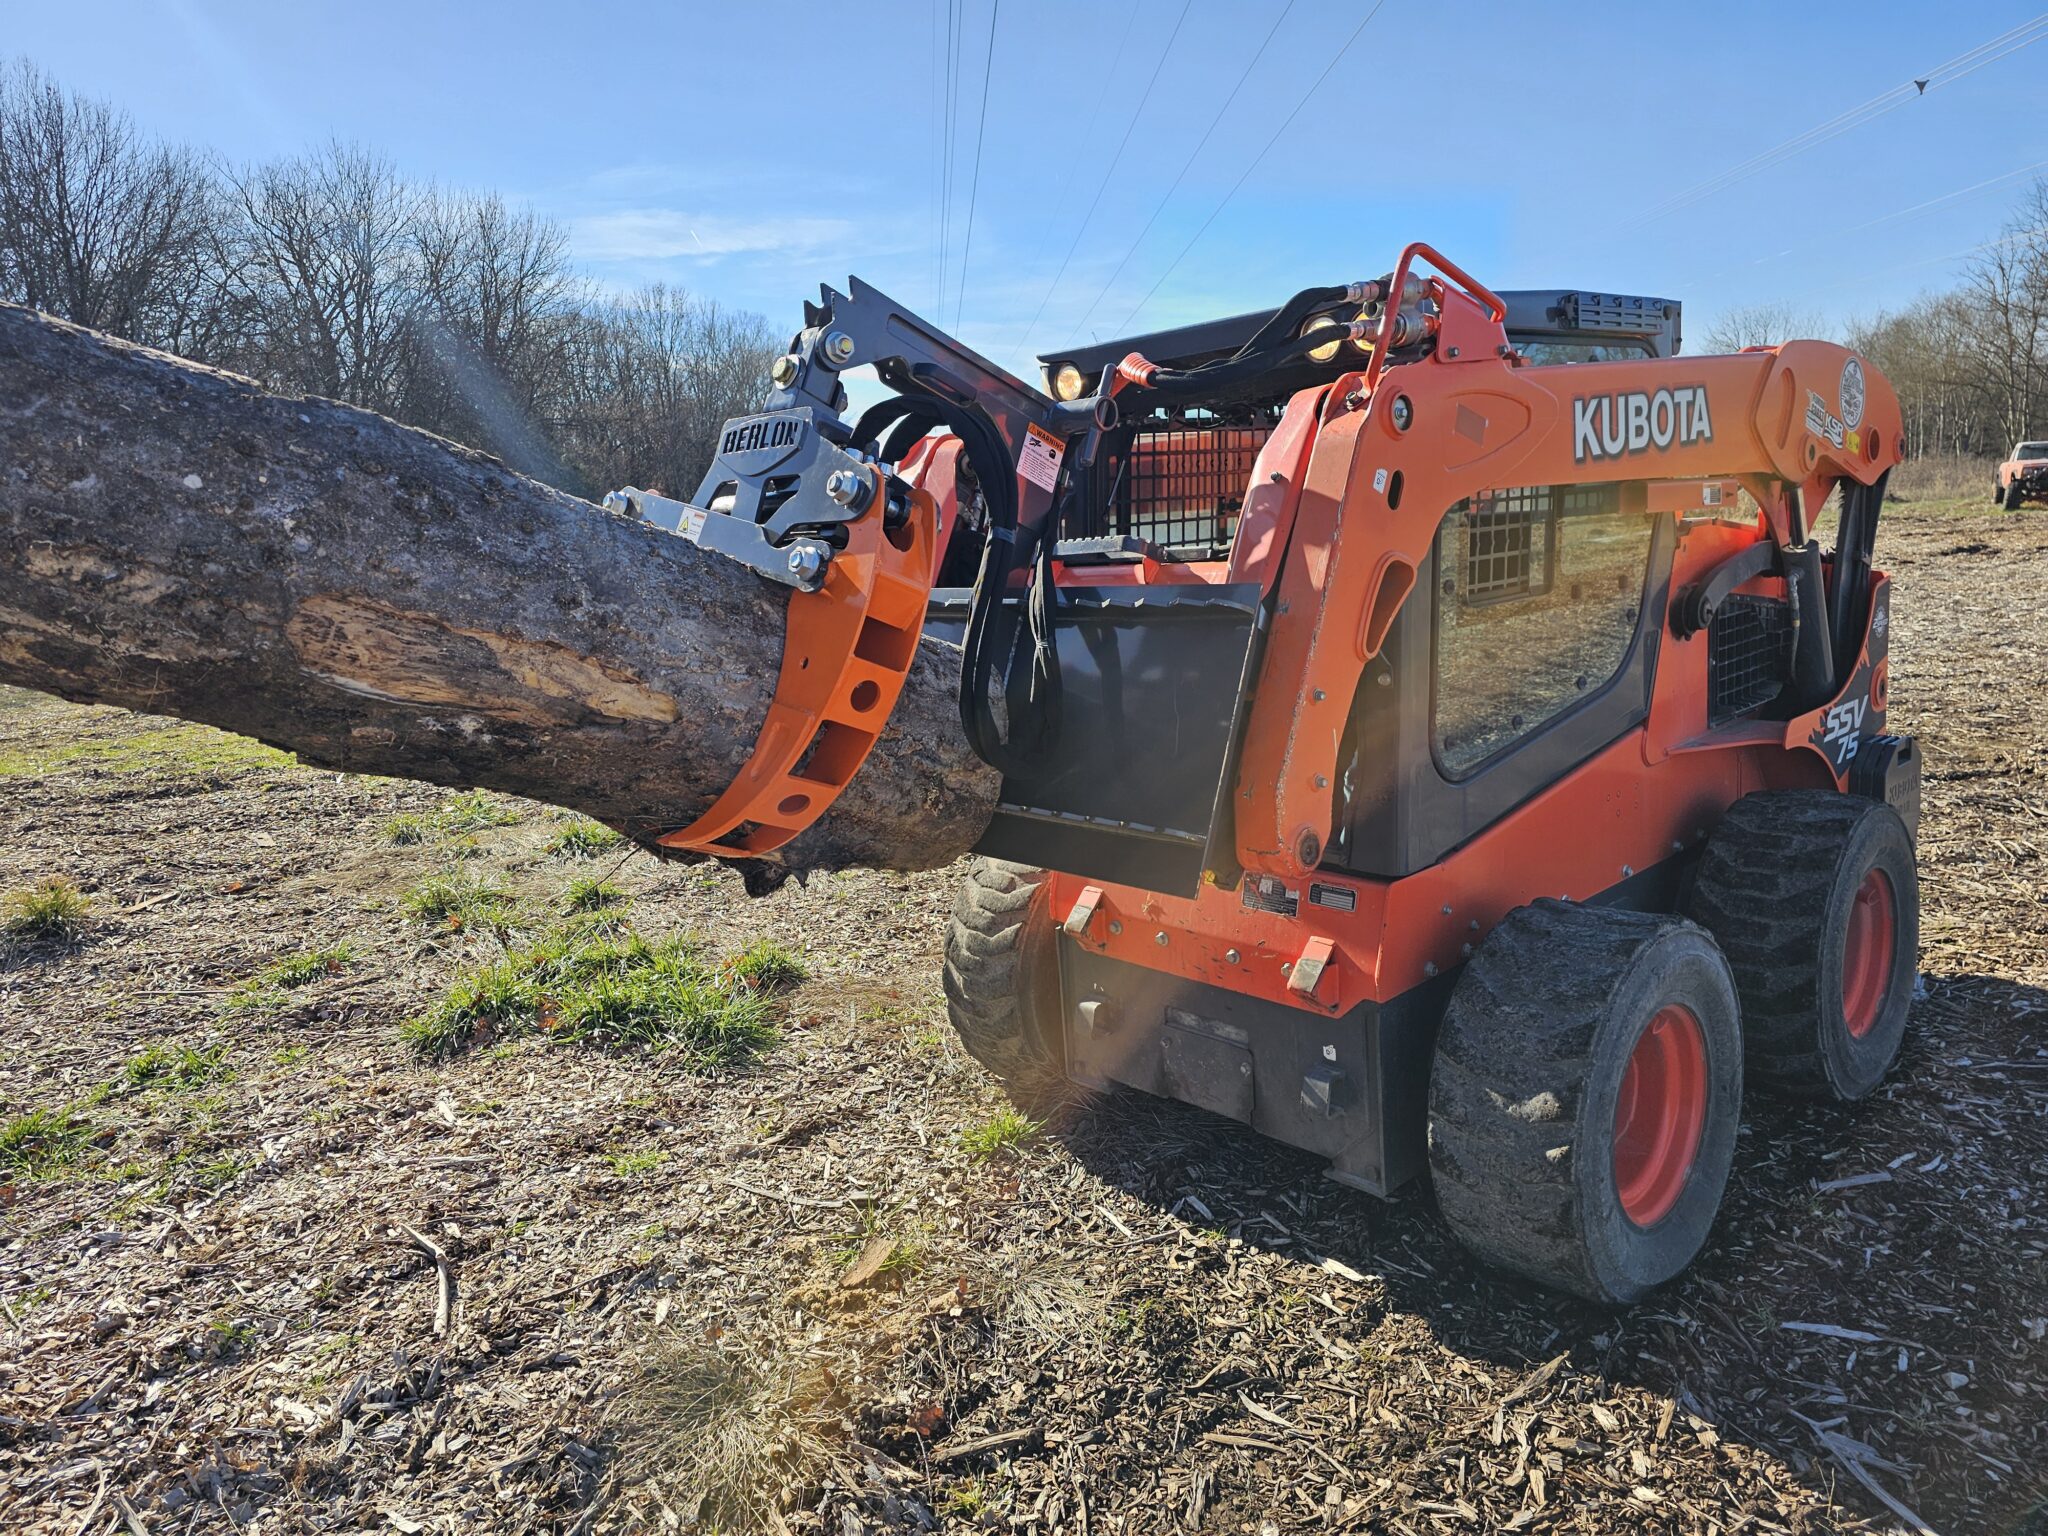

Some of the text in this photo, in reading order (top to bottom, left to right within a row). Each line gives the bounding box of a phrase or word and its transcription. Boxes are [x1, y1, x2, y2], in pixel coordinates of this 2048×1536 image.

[723, 421, 799, 454] BERLON
[1574, 387, 1712, 460] KUBOTA
[1825, 413, 1843, 438] KSR
[1036, 429, 1064, 452] WARNING
[1824, 694, 1869, 743] SSV
[1837, 730, 1860, 764] 75
